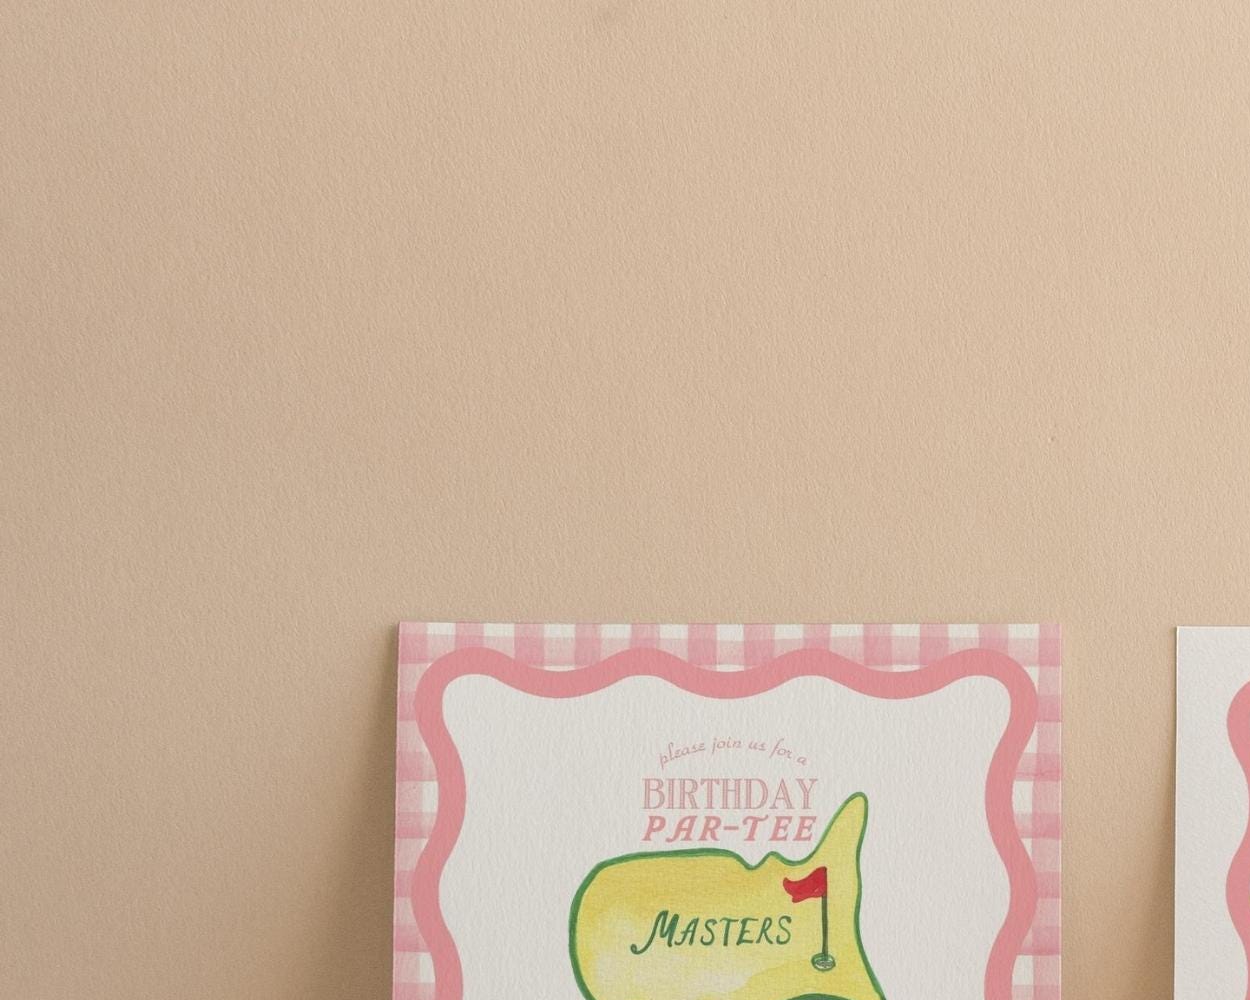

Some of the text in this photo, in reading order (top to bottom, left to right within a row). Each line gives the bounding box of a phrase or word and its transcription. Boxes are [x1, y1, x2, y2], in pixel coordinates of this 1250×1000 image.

[658, 737, 808, 769] please join us for a
[642, 778, 818, 810] BIRTHDAY
[641, 815, 818, 843] PAR-TEE
